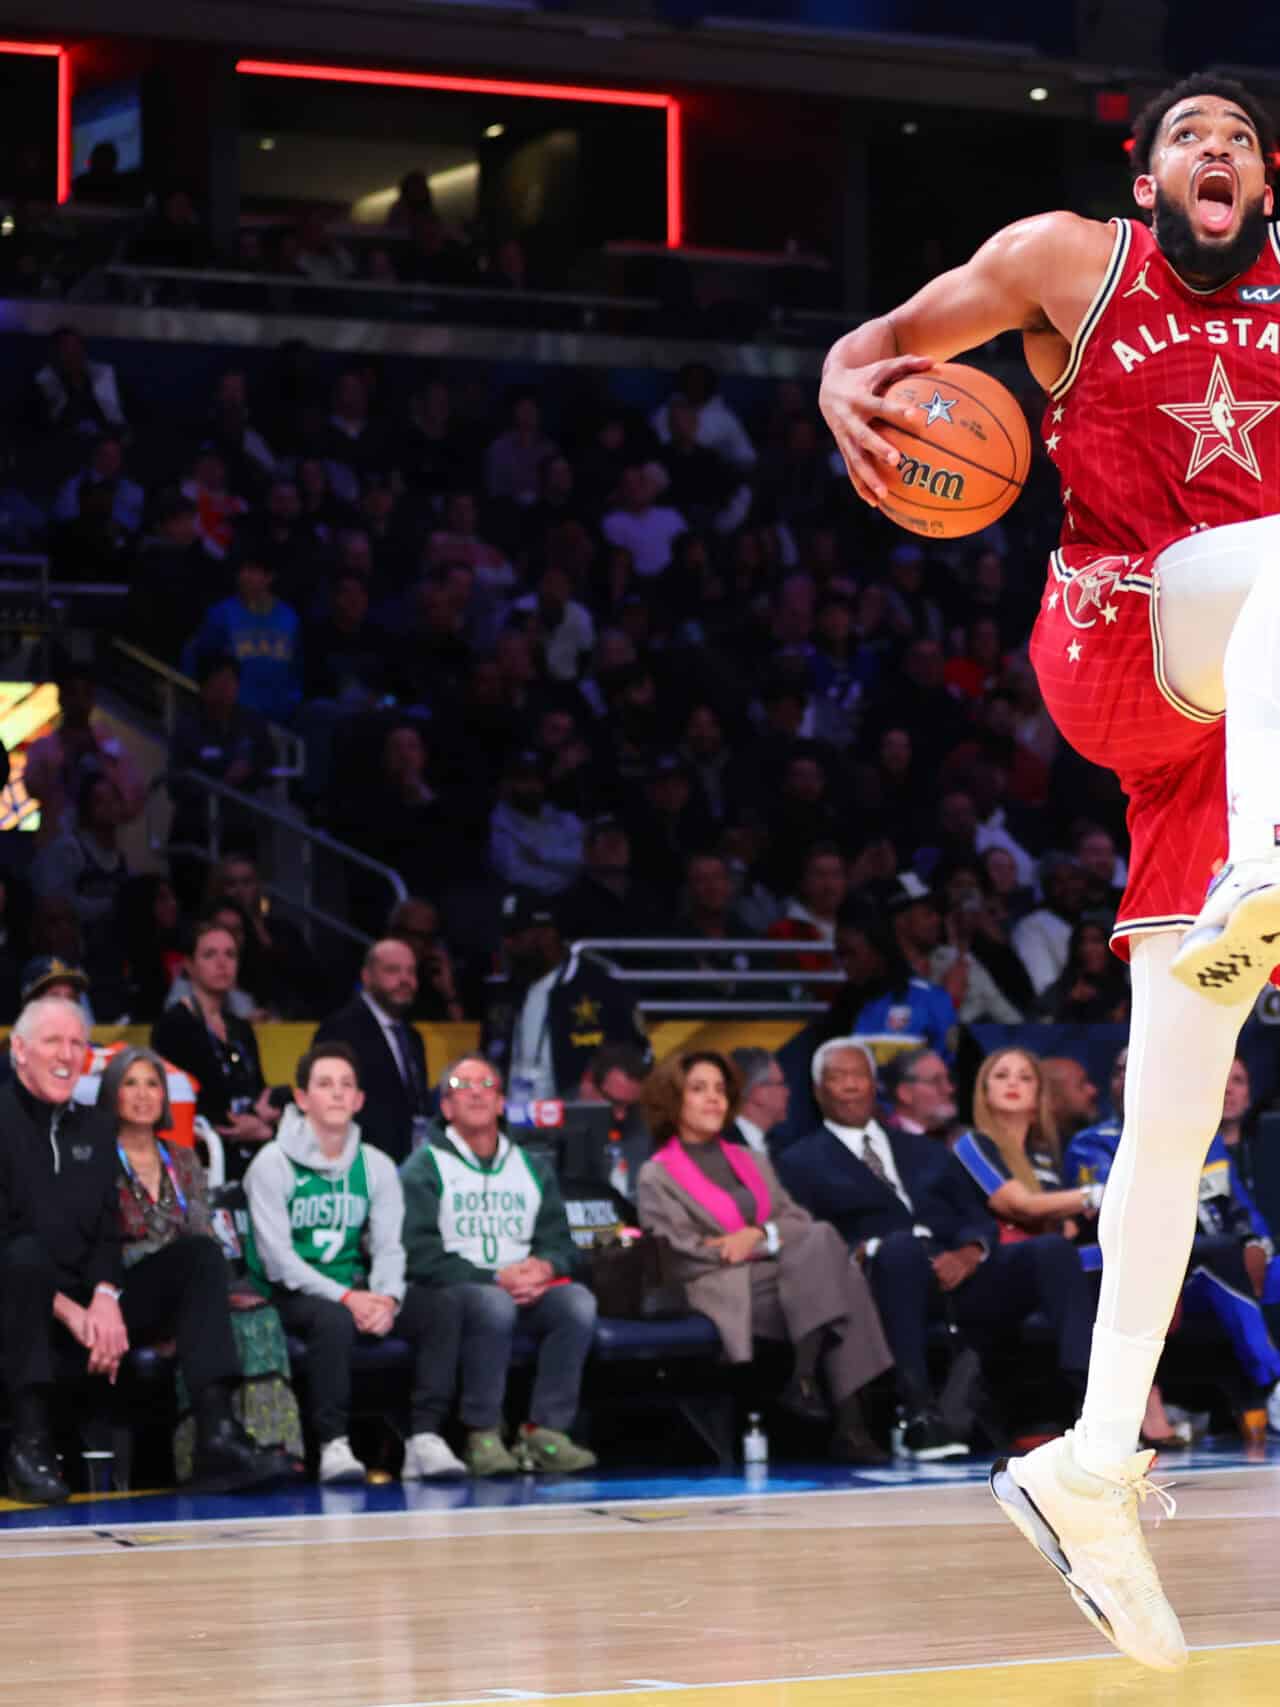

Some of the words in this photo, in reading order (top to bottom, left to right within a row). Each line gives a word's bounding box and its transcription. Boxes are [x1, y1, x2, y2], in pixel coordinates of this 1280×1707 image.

[897, 450, 965, 500] Wil
[453, 1192, 526, 1212] BOSTON
[455, 1216, 524, 1238] CELTICS
[312, 1229, 346, 1264] 7
